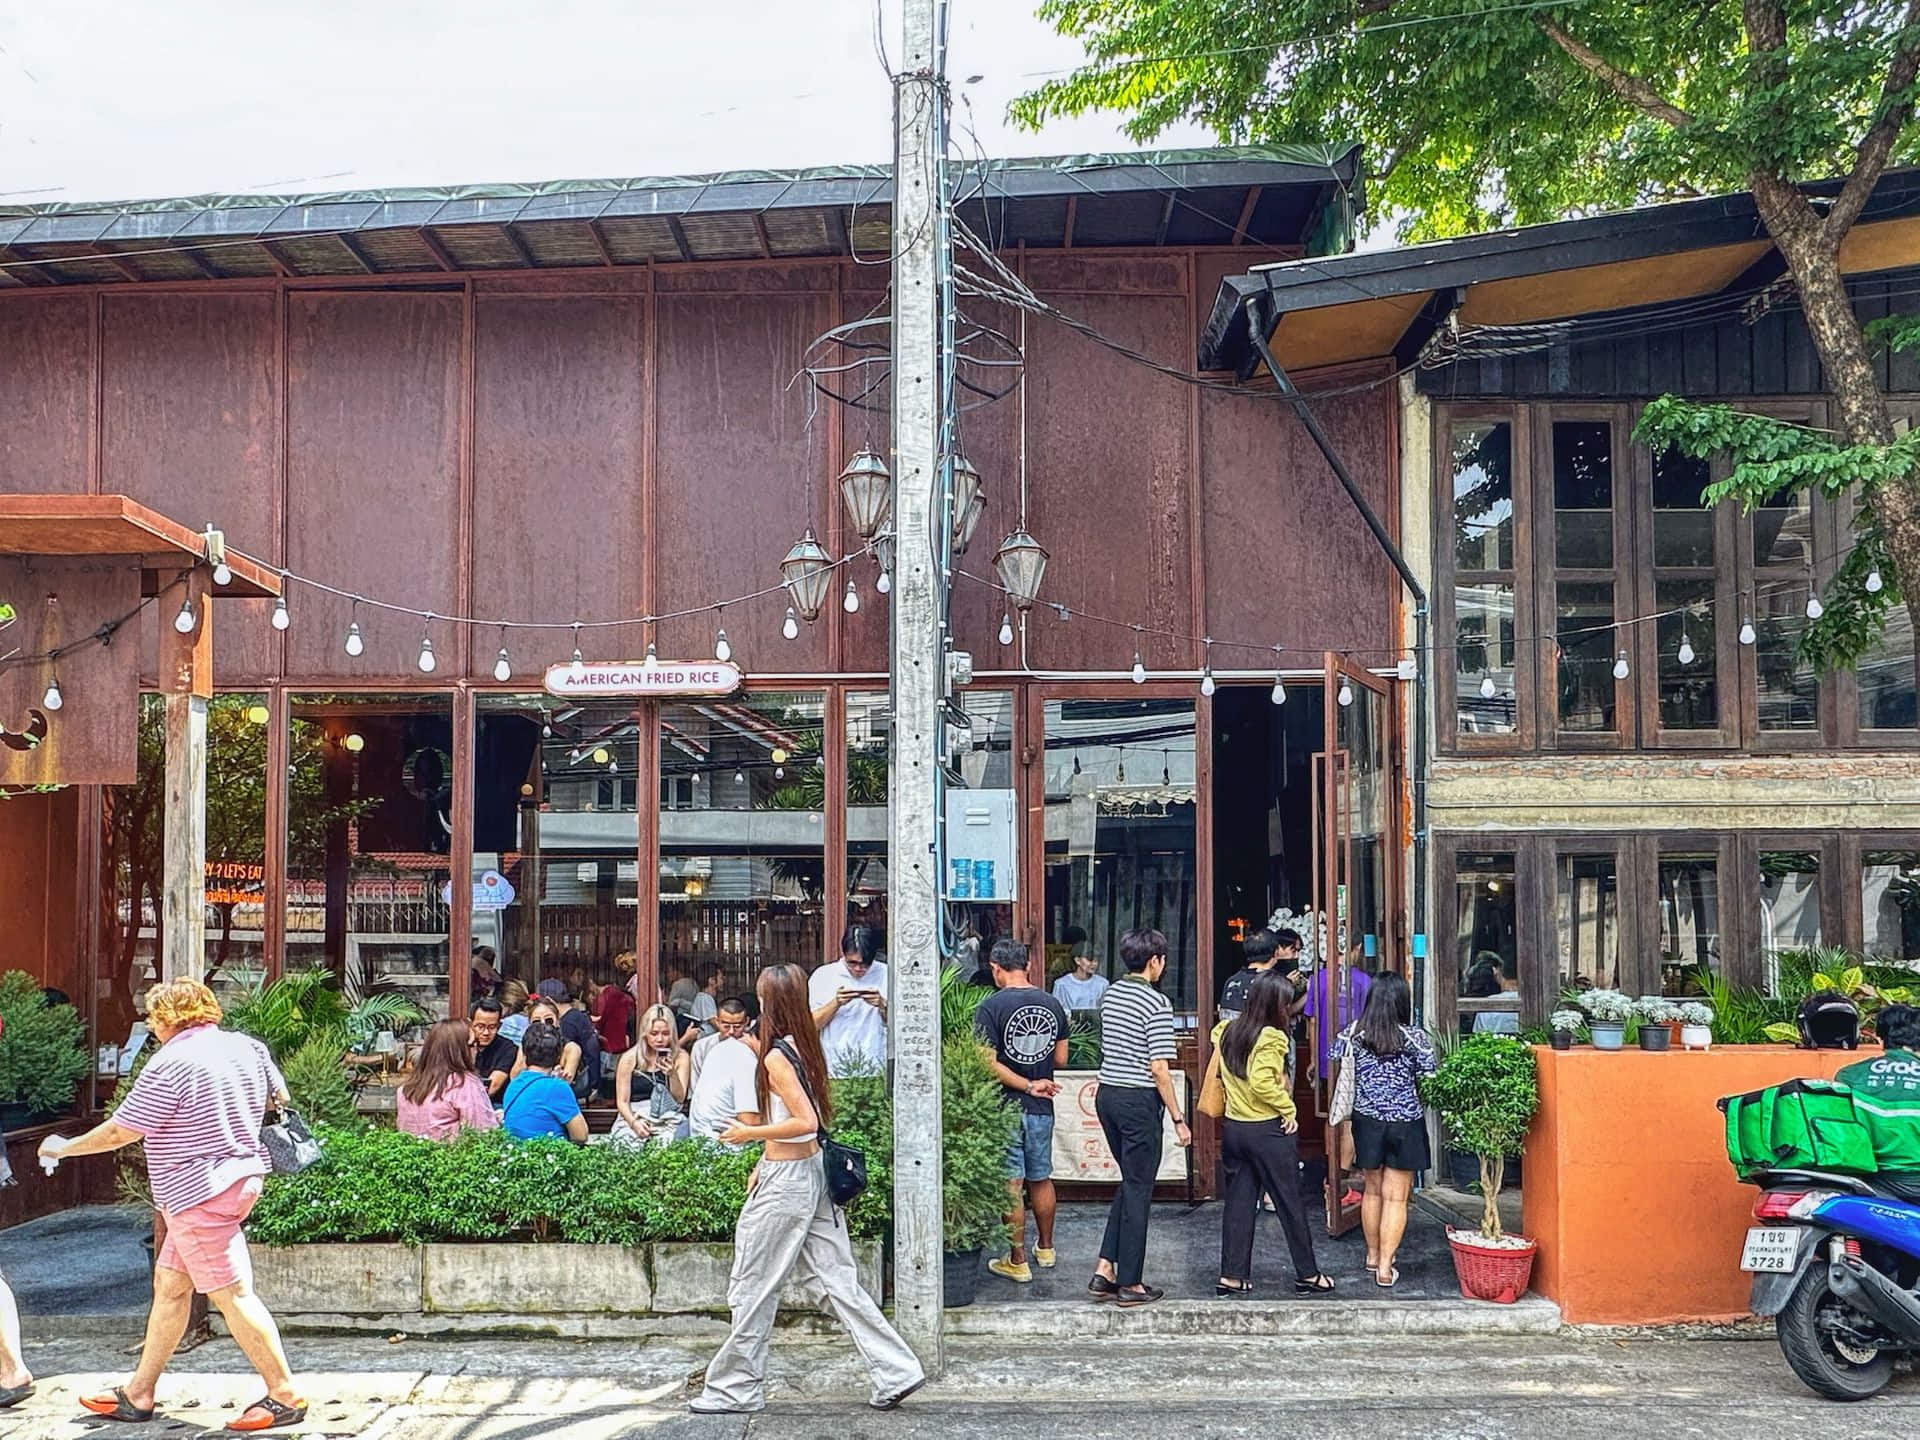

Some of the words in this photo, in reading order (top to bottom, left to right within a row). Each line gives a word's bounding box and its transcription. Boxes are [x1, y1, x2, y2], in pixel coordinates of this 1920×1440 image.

[566, 672, 641, 685] AMERICAN
[647, 672, 684, 684] FRIED
[689, 671, 719, 683] RICE
[224, 863, 246, 879] LET'S
[247, 865, 264, 880] EAT
[1750, 1256, 1785, 1268] 3728
